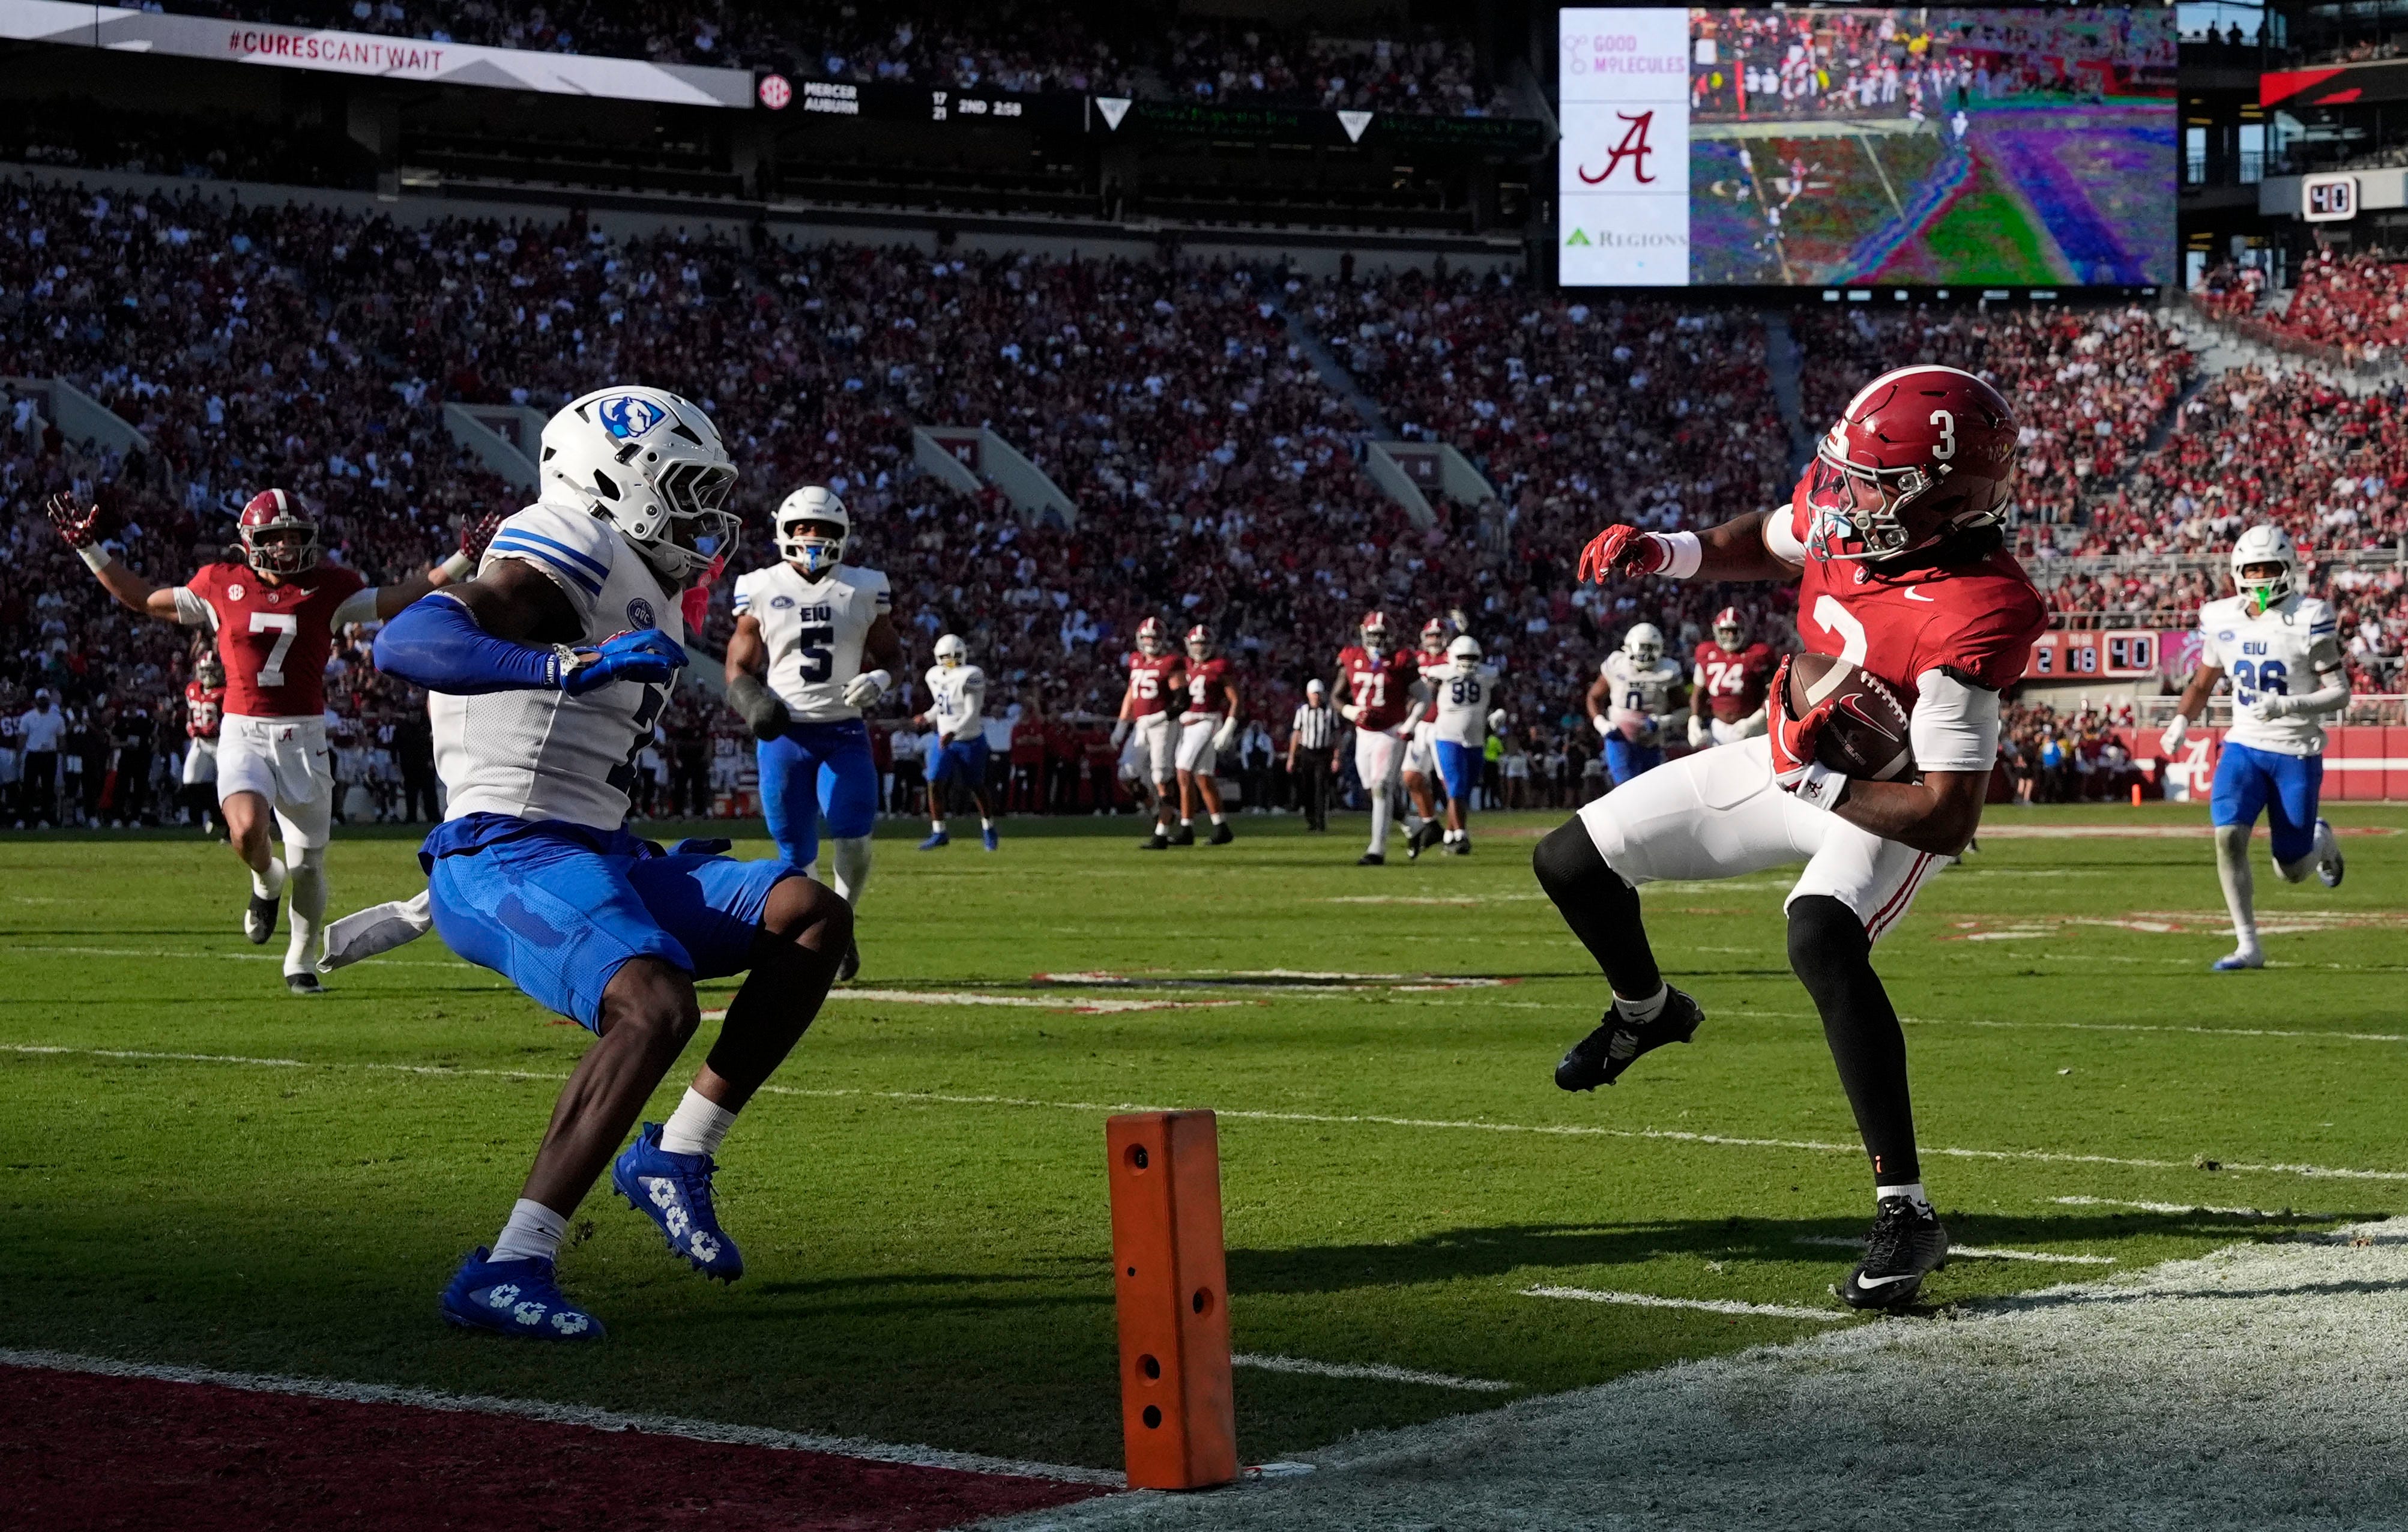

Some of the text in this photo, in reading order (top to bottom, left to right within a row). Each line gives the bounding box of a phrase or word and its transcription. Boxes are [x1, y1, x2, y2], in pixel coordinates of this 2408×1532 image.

[229, 29, 444, 71] #CURESCANTWAIT
[1594, 35, 1637, 52] GOOD
[804, 82, 857, 99] MERCER
[804, 97, 858, 114] AUBURN
[959, 98, 988, 114] 2ND
[2312, 184, 2348, 212] 40
[1930, 410, 1955, 460] 3
[228, 584, 245, 601] SEC
[801, 606, 831, 622] EIU
[249, 612, 297, 687] 7
[800, 626, 834, 683] 5
[2037, 647, 2053, 673] 2
[2073, 647, 2096, 673] 18
[2111, 638, 2149, 668] 40
[2243, 642, 2267, 655] EIU
[1130, 668, 1159, 699] 75
[1353, 672, 1386, 707] 71
[1452, 679, 1481, 704] 99
[1706, 662, 1744, 696] 74
